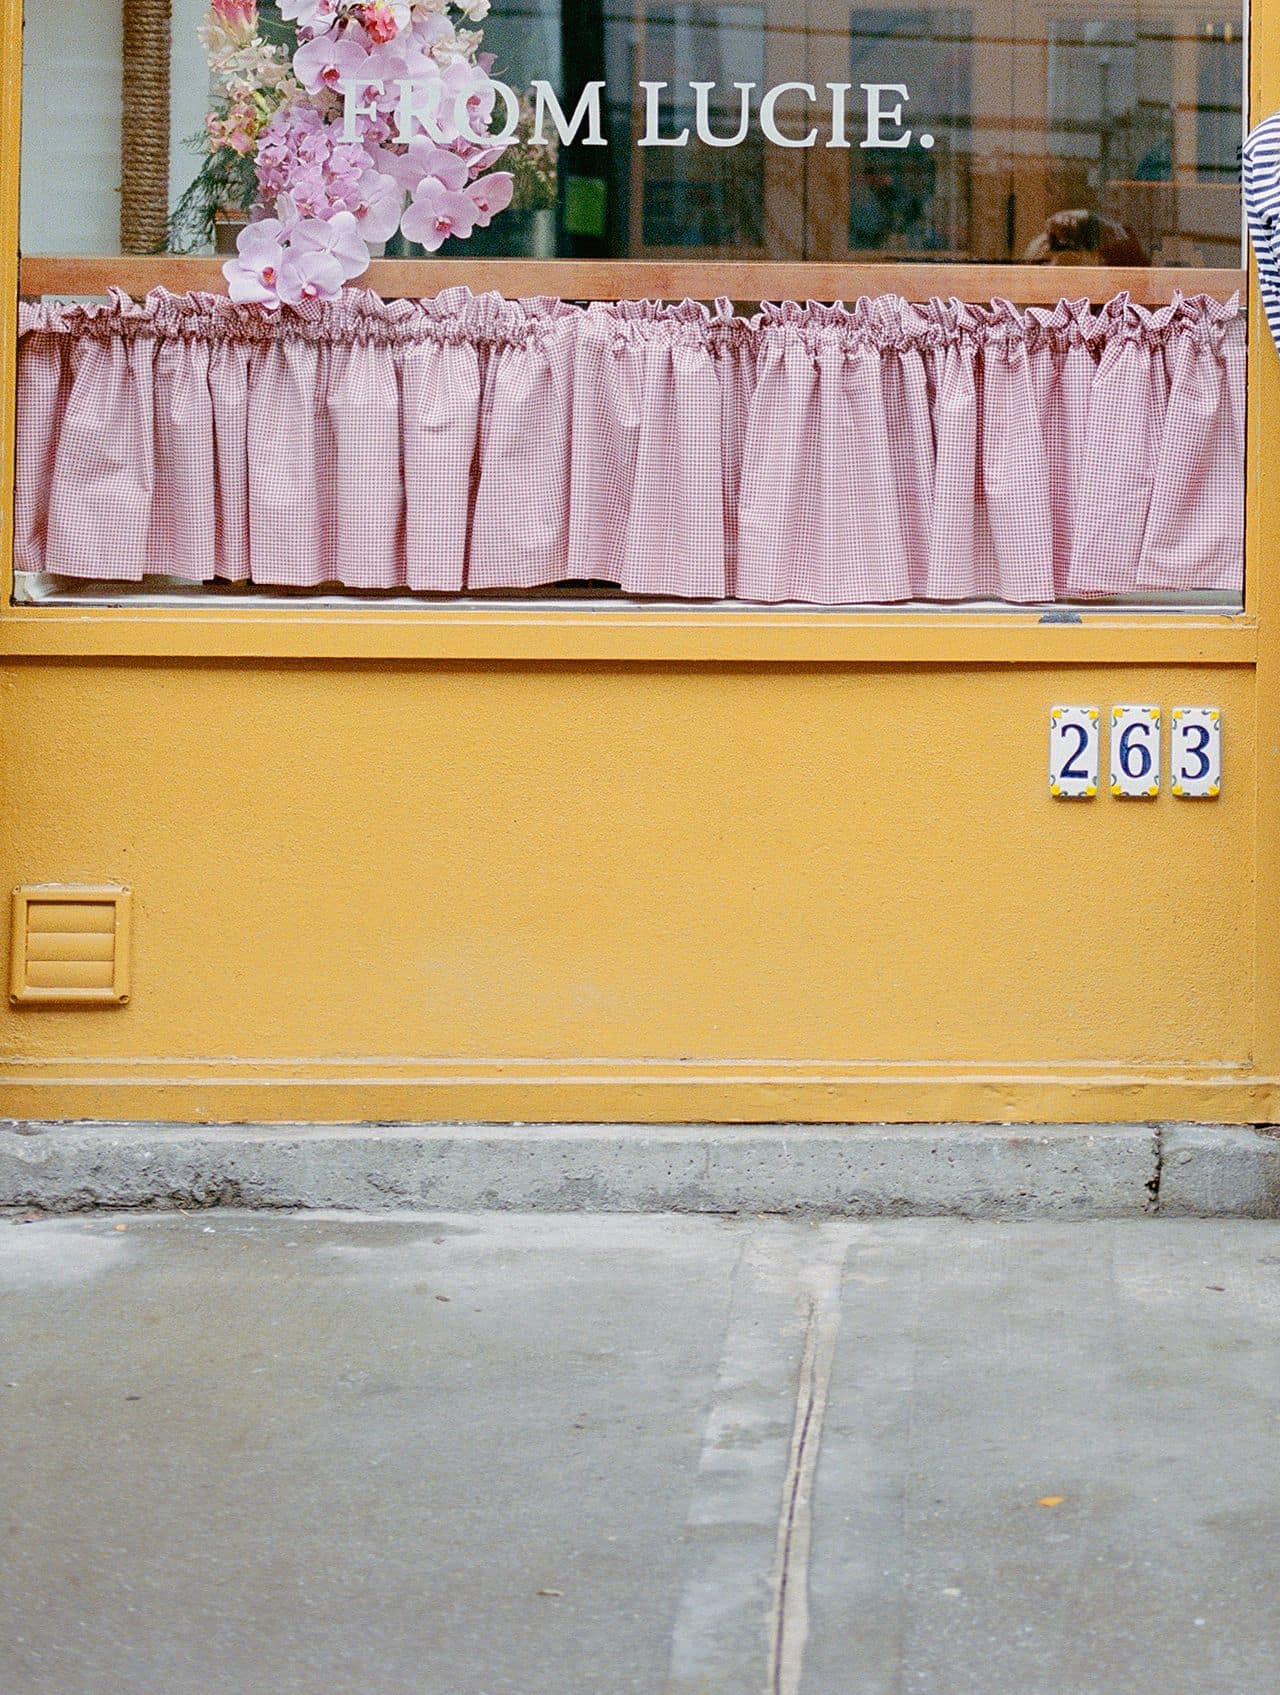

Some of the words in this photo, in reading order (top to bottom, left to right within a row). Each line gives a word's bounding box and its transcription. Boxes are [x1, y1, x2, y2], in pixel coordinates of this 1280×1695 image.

[336, 78, 608, 147] FROM
[637, 81, 936, 149] LUCIE.
[1059, 722, 1211, 780] 263
